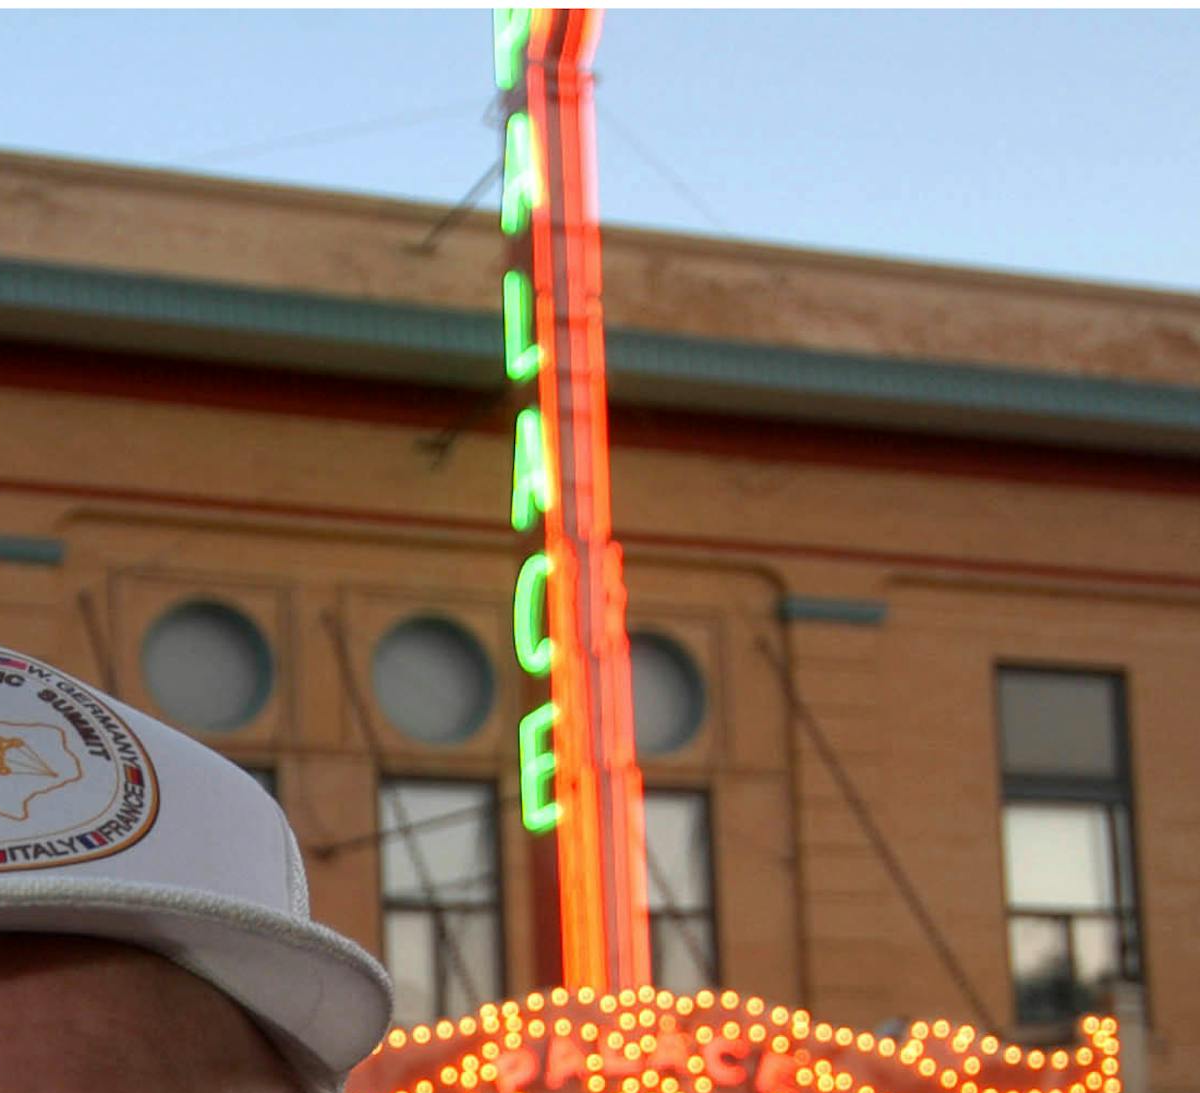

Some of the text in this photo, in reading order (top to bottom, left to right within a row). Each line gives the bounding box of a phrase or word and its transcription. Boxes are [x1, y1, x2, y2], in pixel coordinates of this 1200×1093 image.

[37, 688, 112, 762] SUMMIT
[56, 681, 140, 765] GERMANY
[101, 780, 145, 843] FRANCE
[7, 836, 79, 862] ITALY
